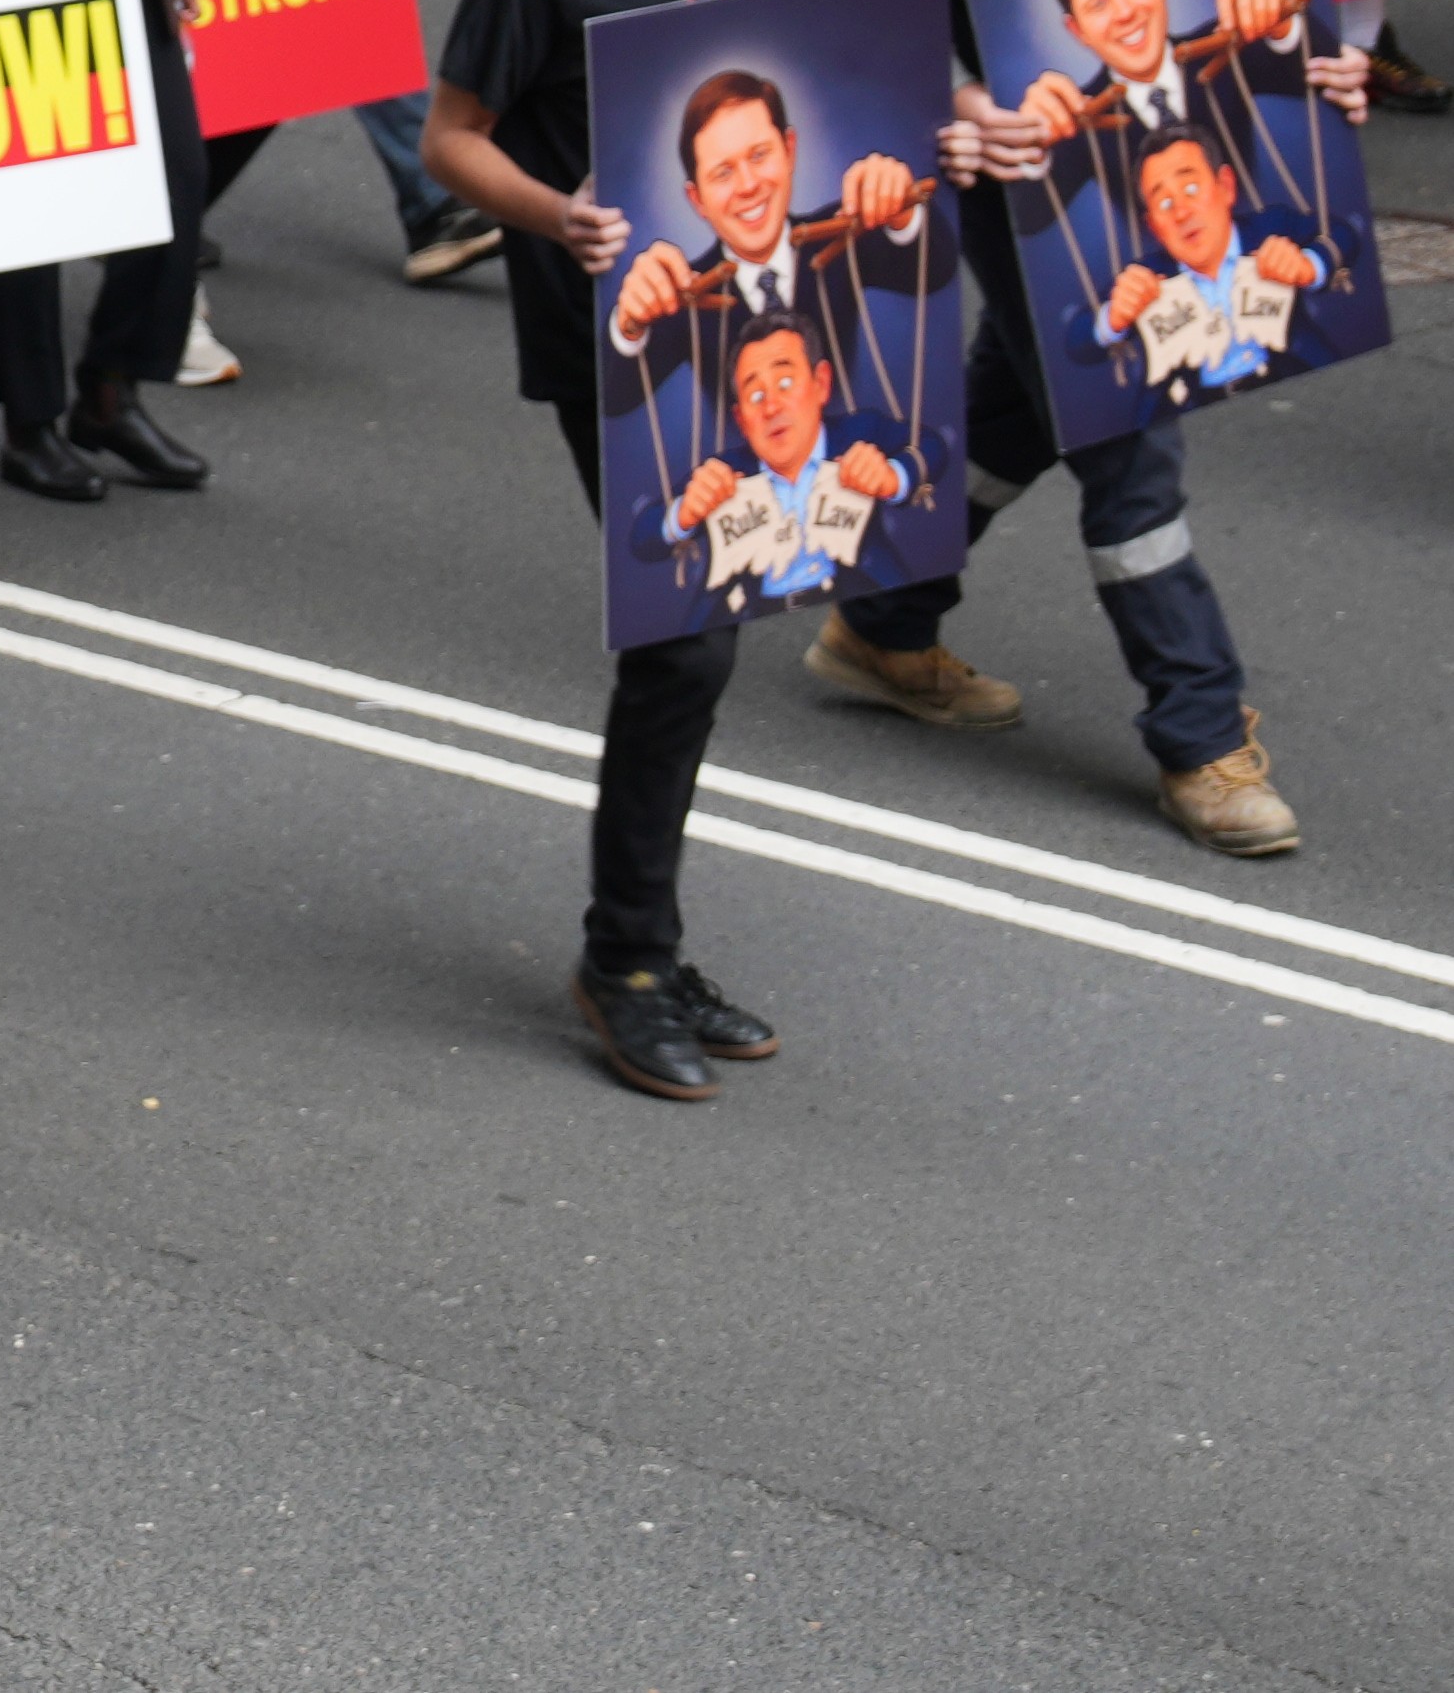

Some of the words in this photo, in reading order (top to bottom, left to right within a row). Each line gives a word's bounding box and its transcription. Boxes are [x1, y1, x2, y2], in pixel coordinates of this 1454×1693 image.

[717, 499, 770, 546] Rule
[774, 523, 795, 544] of
[812, 494, 864, 533] Law
